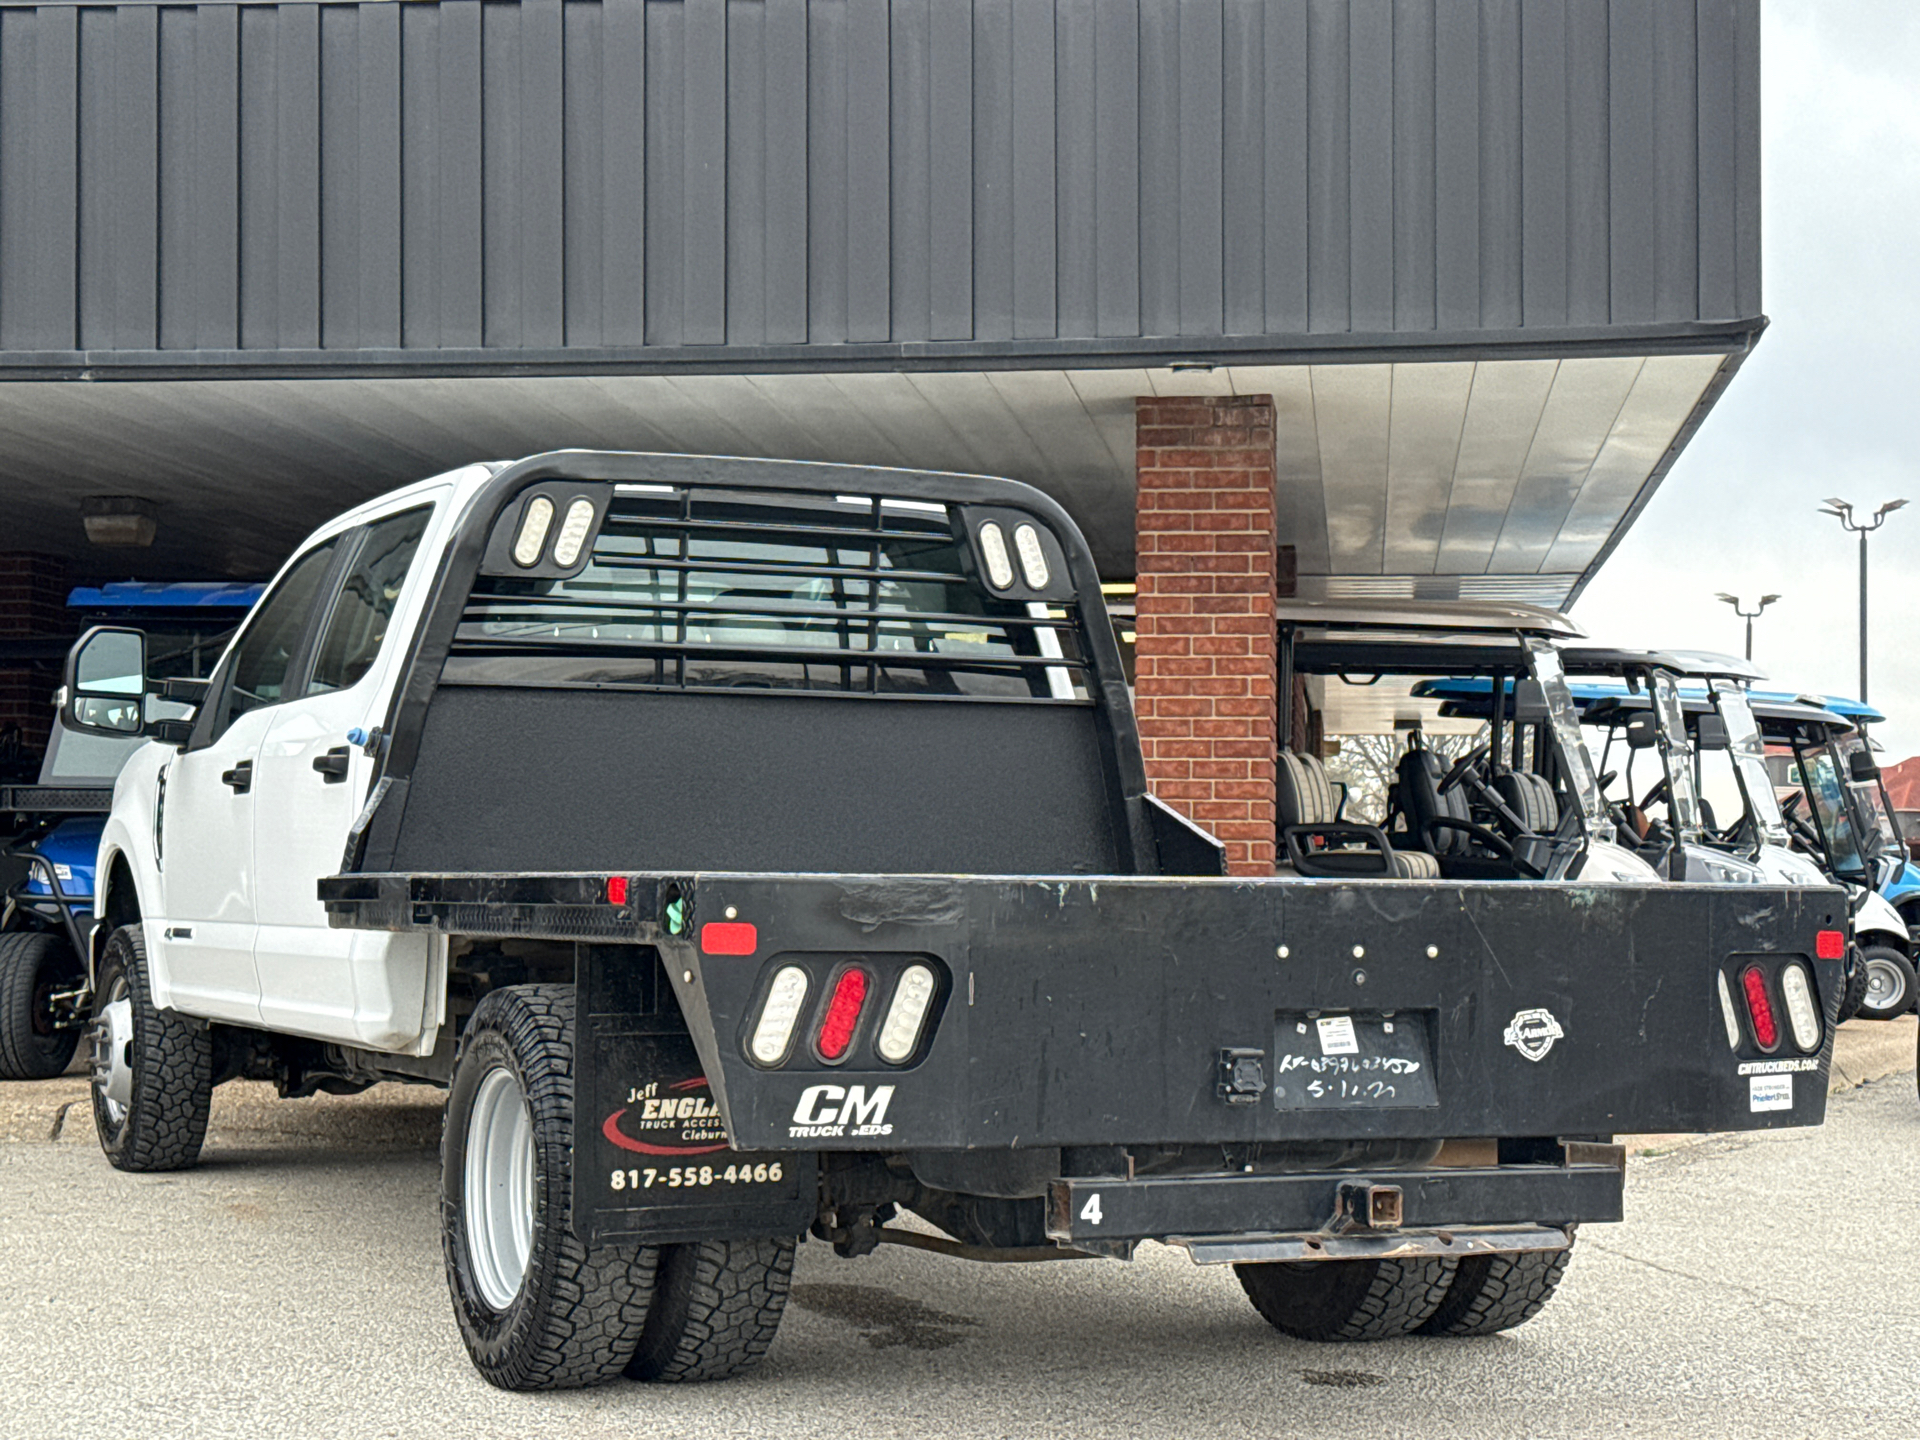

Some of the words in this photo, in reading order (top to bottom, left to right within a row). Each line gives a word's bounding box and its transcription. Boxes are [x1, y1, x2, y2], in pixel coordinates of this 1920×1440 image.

[627, 1082, 658, 1103] Jeff
[793, 1085, 896, 1125] CM
[640, 1120, 676, 1130] TRUCK
[789, 1125, 845, 1138] TRUCK
[610, 1162, 783, 1190] 817-558-4466
[1080, 1193, 1103, 1225] 4
